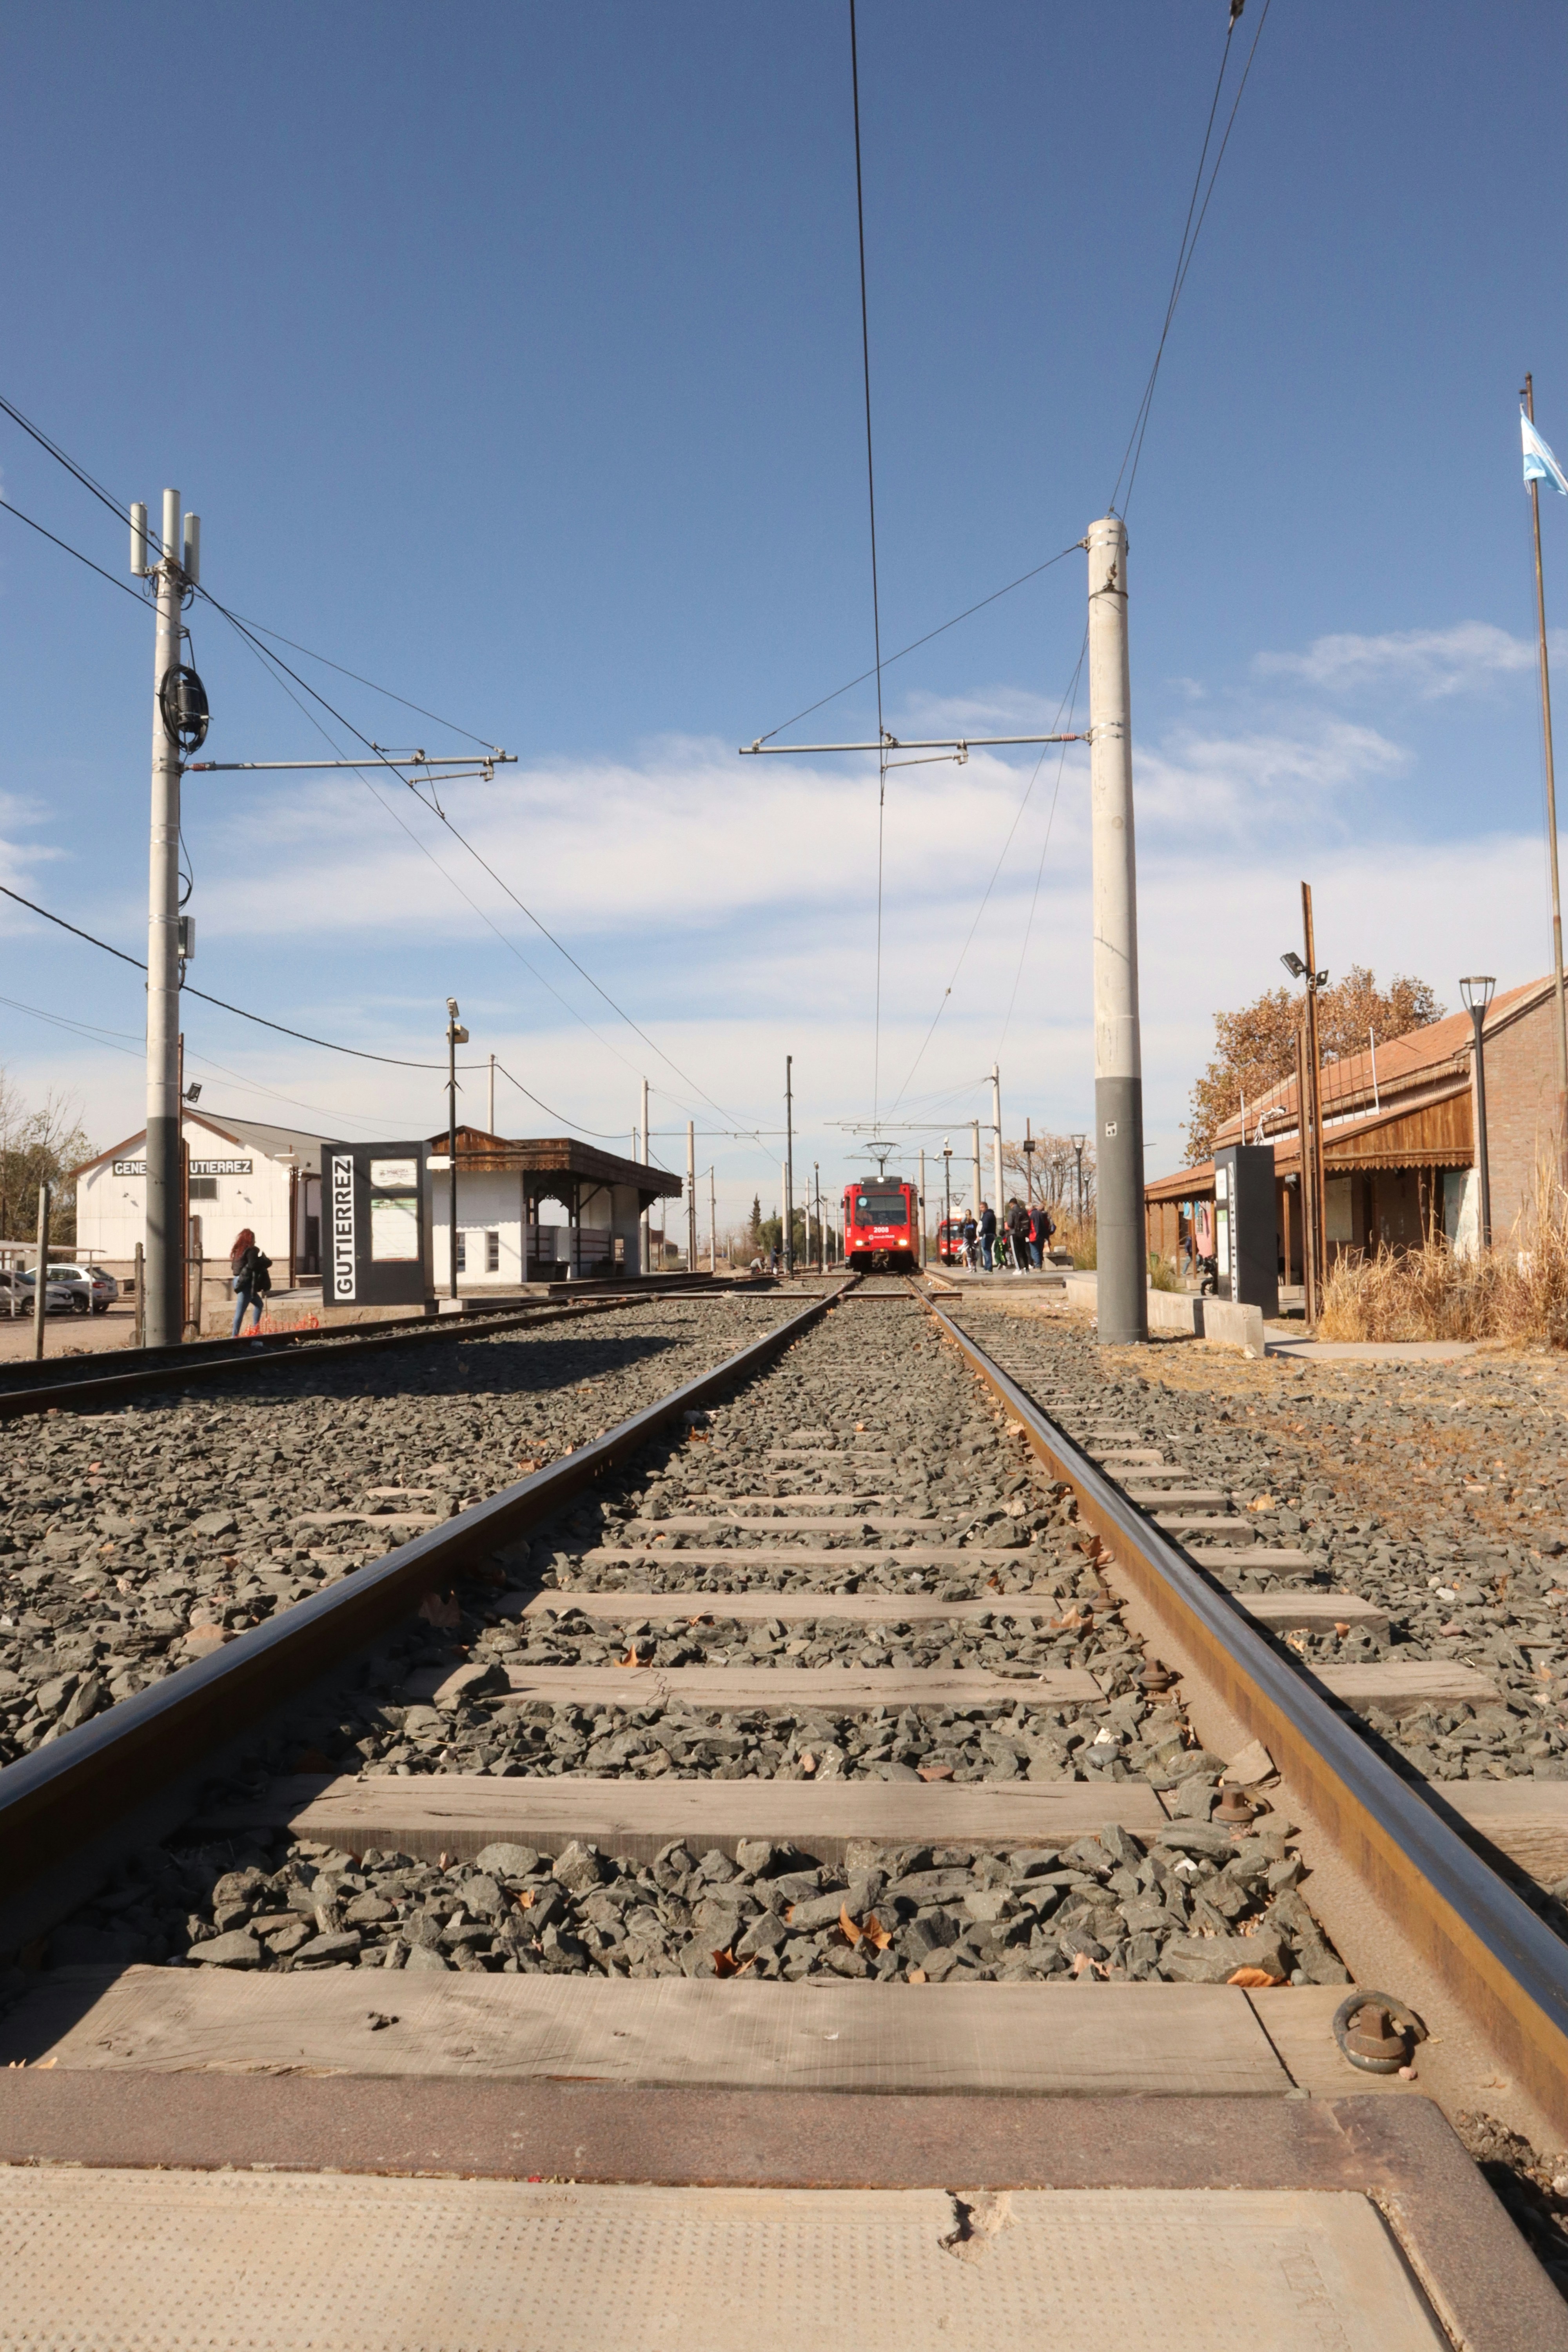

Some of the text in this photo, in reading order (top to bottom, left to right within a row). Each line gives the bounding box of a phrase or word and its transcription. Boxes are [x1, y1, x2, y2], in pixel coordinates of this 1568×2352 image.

[115, 1160, 250, 1174] GENE UTIERREZ
[335, 1160, 353, 1294] GUTIERREZ
